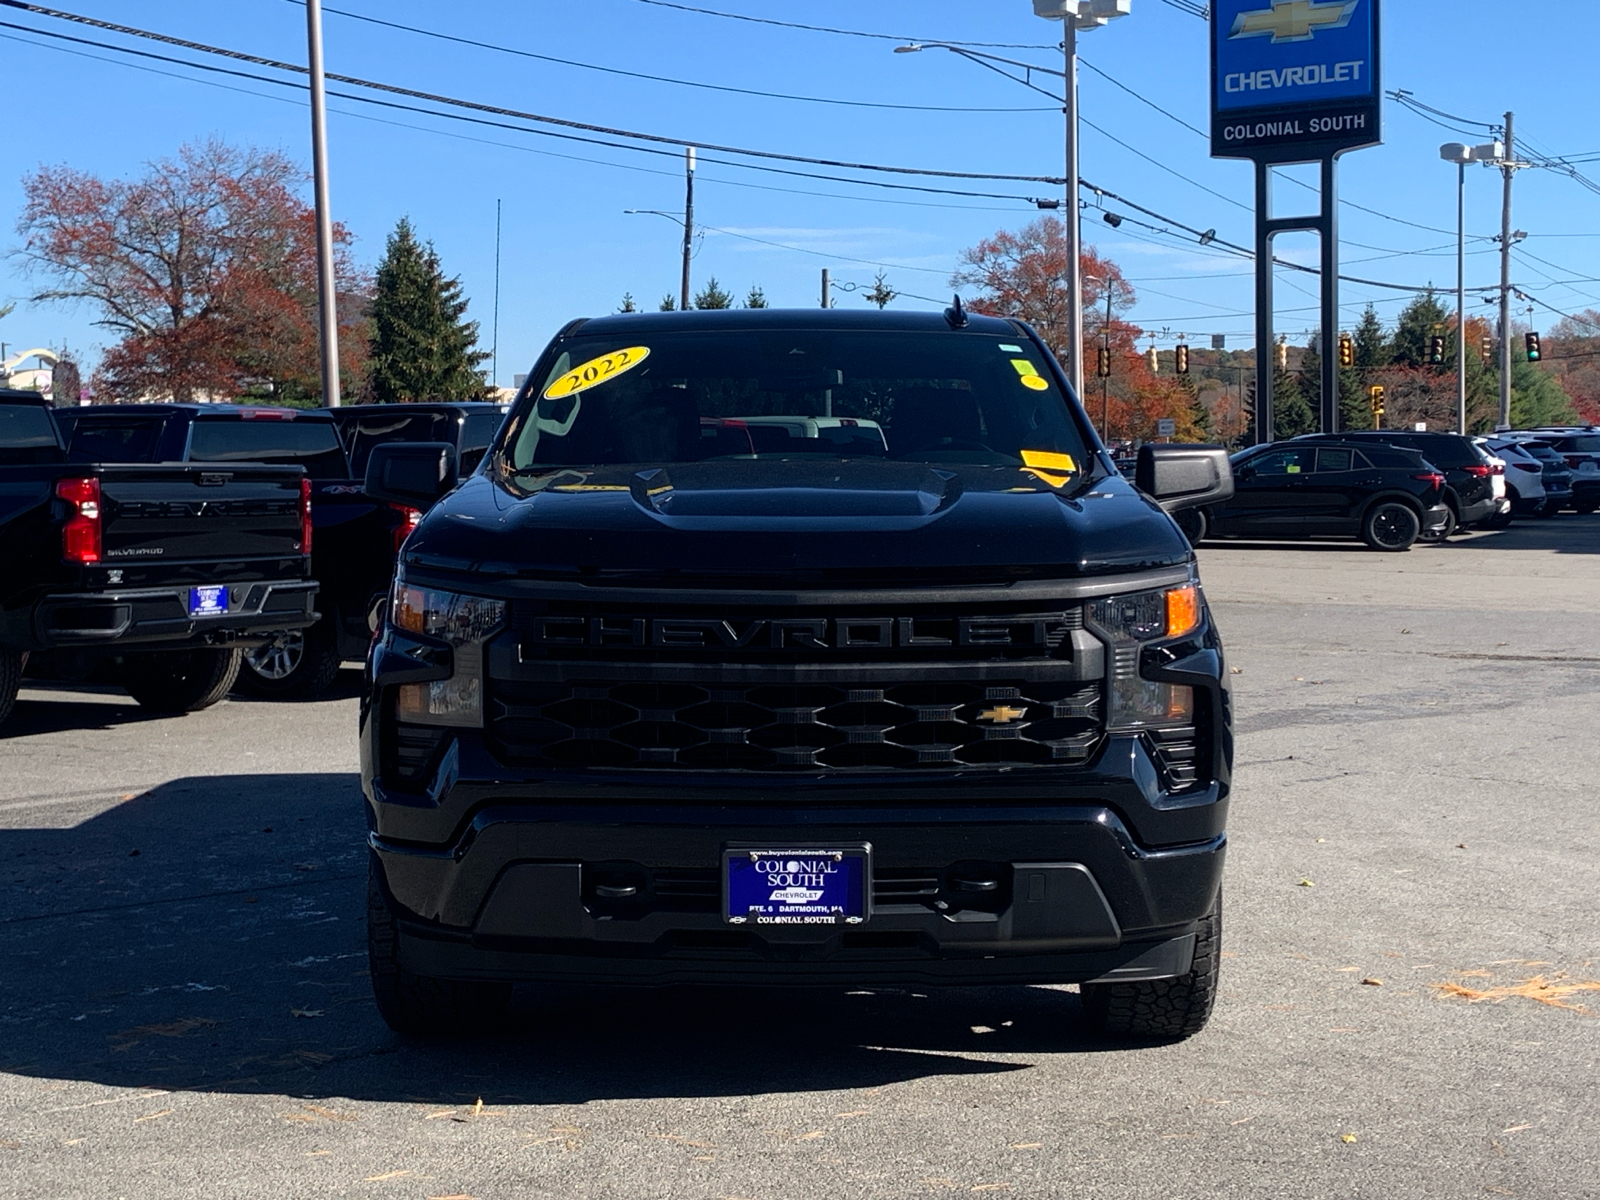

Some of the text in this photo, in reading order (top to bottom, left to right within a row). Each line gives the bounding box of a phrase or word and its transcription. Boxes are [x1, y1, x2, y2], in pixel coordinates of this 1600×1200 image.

[1225, 60, 1364, 93] CHEVROLET
[1224, 114, 1365, 141] COLONIAL SOUTH
[566, 352, 632, 391] 2022
[532, 612, 1066, 649] CHEVROLET
[755, 860, 838, 873] COLONIAL
[768, 874, 825, 886] SOUTH
[779, 905, 830, 914] DARTMOUTH,
[757, 916, 836, 924] COLONIAL SOUTH
